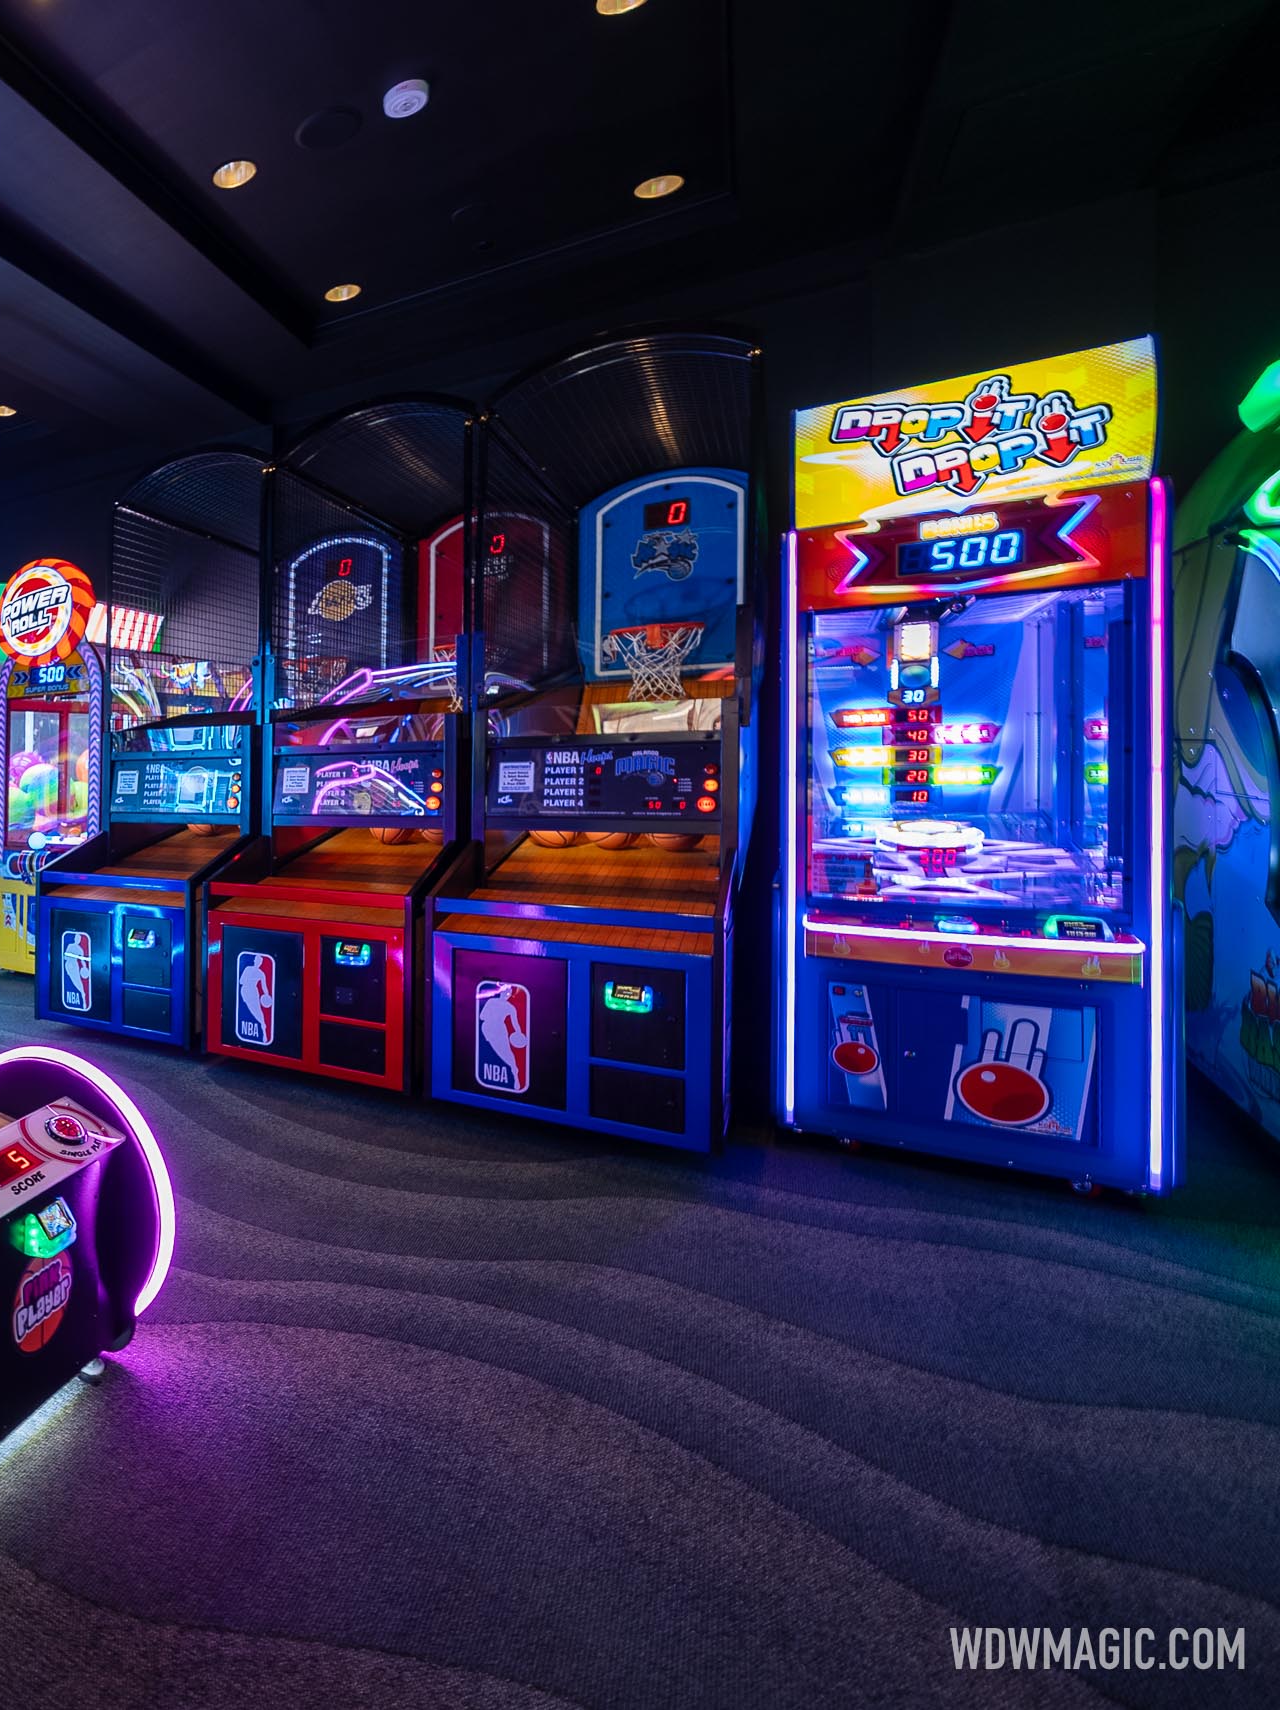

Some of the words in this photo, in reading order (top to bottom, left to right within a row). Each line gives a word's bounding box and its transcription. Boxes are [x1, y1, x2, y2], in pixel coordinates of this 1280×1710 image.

[833, 405, 966, 455] DROP
[898, 436, 1038, 494] DROP
[667, 502, 686, 525] 0
[930, 531, 1021, 573] 500
[1, 584, 70, 627] POWER
[10, 606, 54, 637] ROLL
[38, 665, 65, 683] 500
[902, 689, 925, 704] 30
[907, 709, 929, 722] 50
[908, 729, 928, 742] 40
[553, 751, 580, 764] NBA
[907, 749, 928, 762] 30
[545, 766, 577, 774] PLAYER
[579, 766, 584, 774] 1
[615, 755, 676, 776] MAGIC
[544, 777, 577, 785] PLAYER
[578, 777, 584, 785] 2
[907, 769, 928, 782] 20
[544, 788, 577, 797] PLAYER
[578, 788, 584, 796] 3
[911, 790, 928, 803] 10
[544, 799, 577, 807] PLAYER
[577, 799, 584, 807] 4
[66, 991, 80, 1006] NBA
[241, 1021, 260, 1038] NBA
[483, 1062, 509, 1084] NBA
[6, 1150, 31, 1170] 5
[59, 1149, 93, 1158] SINGLE
[11, 1170, 47, 1196] SCORE
